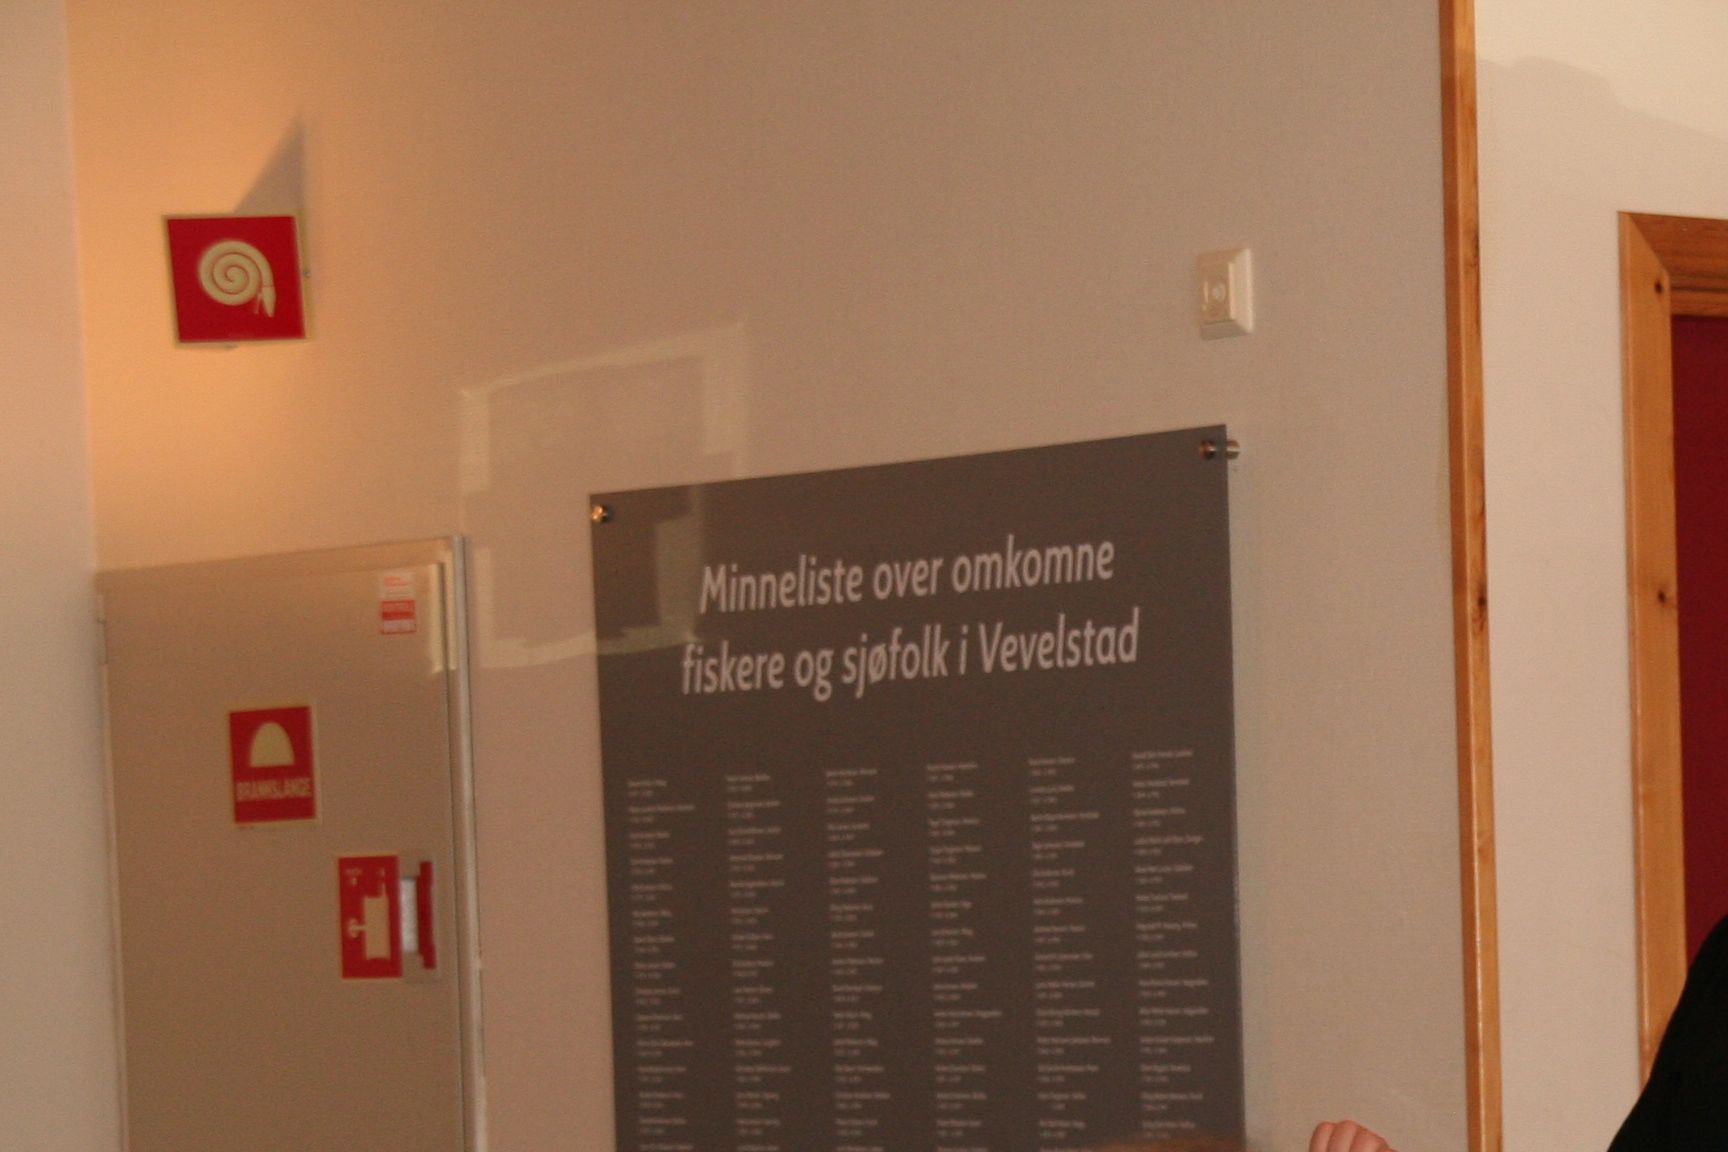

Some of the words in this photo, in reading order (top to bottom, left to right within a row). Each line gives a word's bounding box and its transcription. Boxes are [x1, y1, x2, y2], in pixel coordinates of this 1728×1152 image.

[698, 554, 864, 614] Minneliste
[873, 557, 943, 600] over
[952, 533, 1115, 593] omkomne
[682, 639, 785, 695] fiskere
[794, 648, 834, 701] og
[841, 623, 950, 699] sjøfolk
[958, 624, 969, 676] i
[978, 606, 1140, 674] Vevelstad
